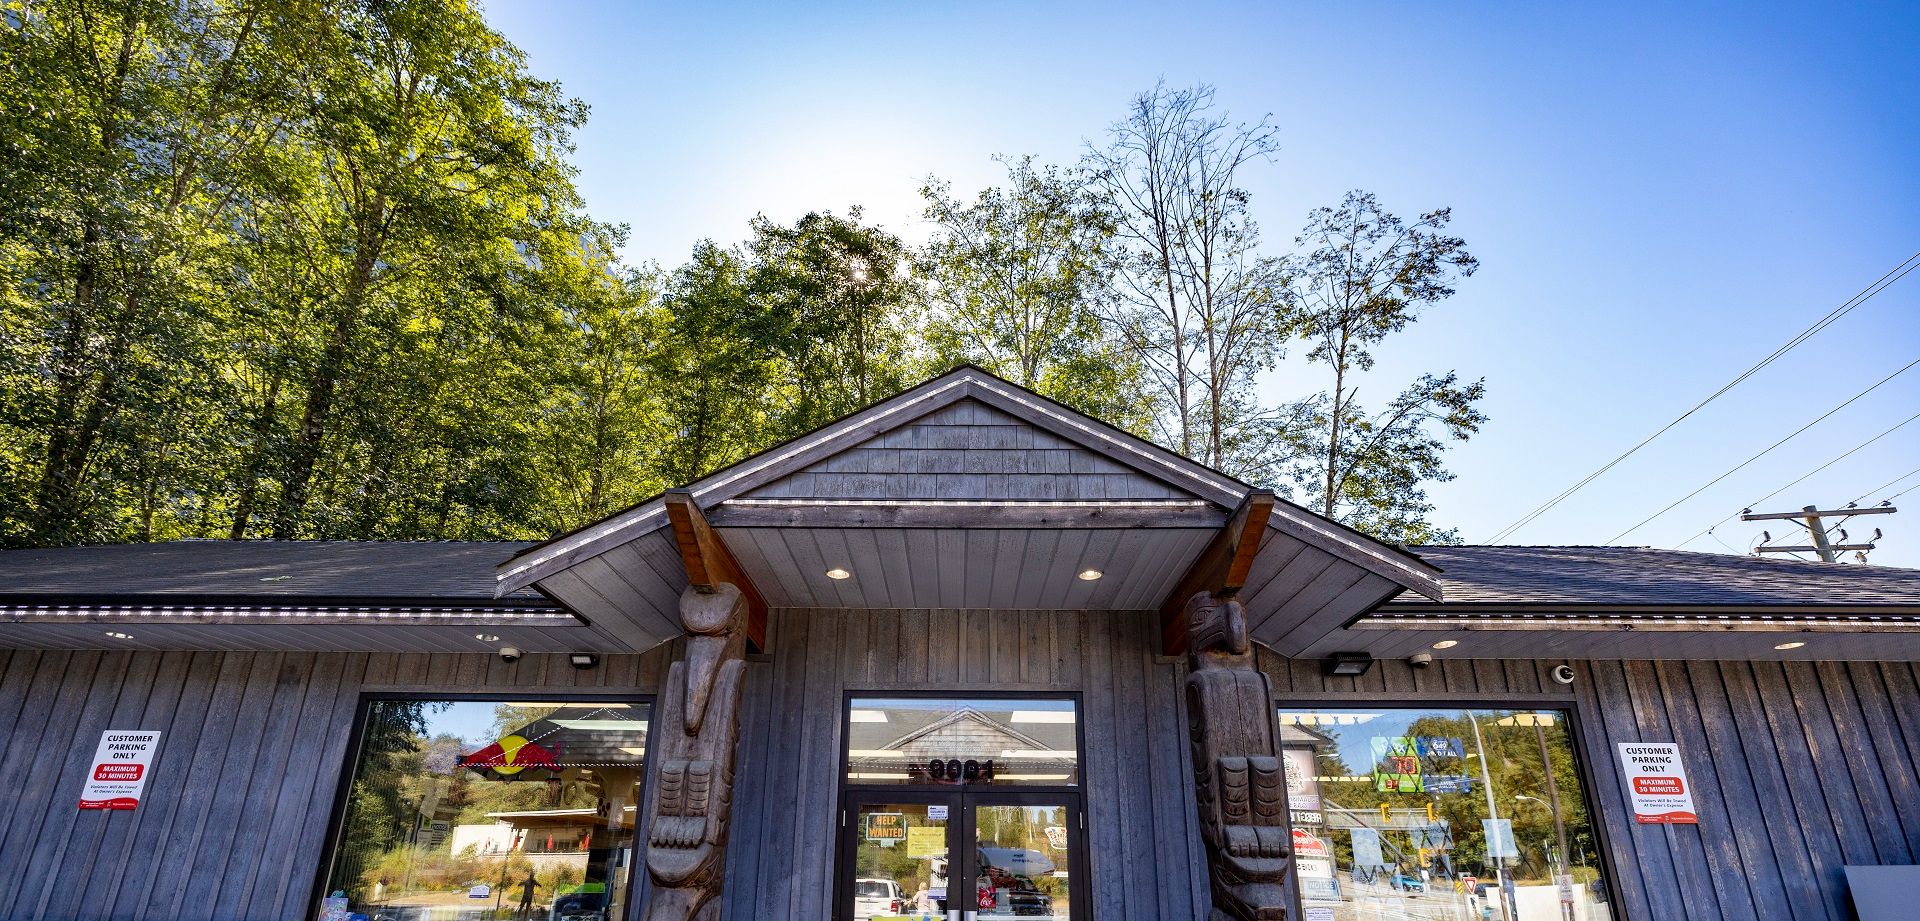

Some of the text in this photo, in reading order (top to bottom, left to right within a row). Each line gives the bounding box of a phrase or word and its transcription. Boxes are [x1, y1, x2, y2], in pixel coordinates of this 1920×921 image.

[1626, 747, 1673, 755] CUSTOMER
[876, 815, 897, 825] HELP
[869, 827, 903, 838] WANTED
